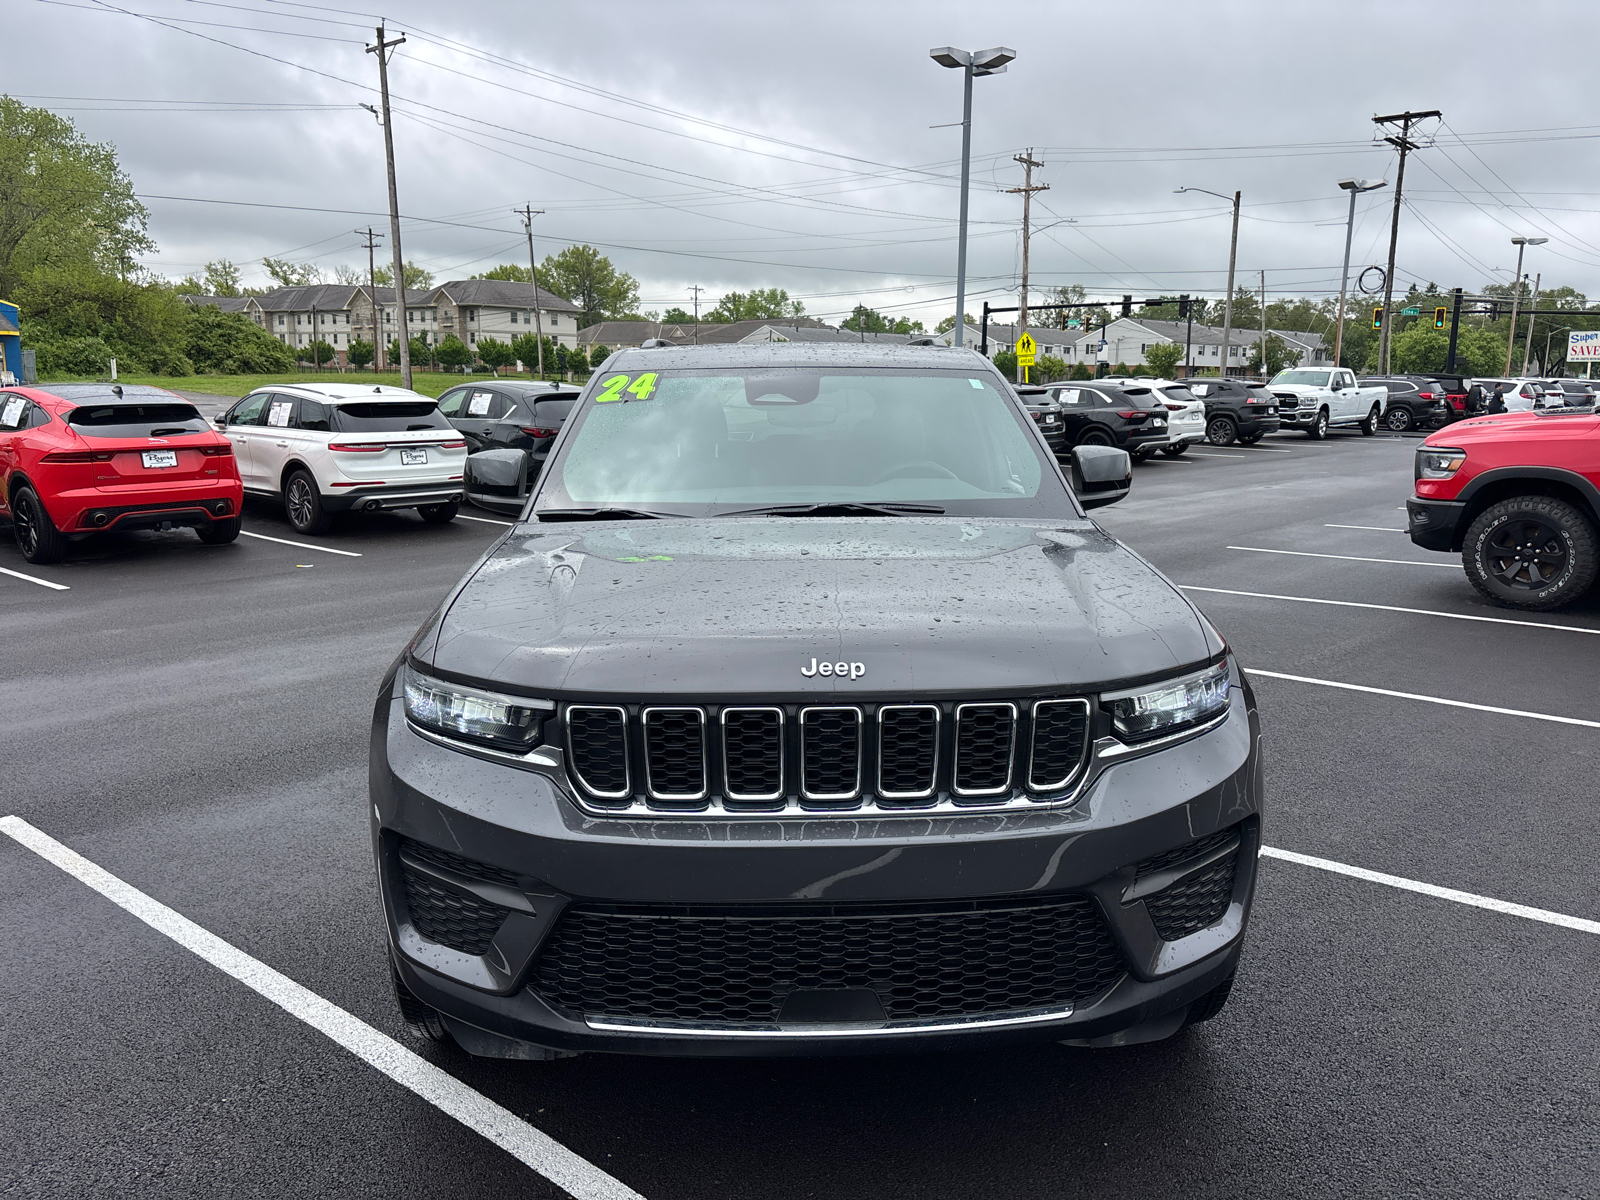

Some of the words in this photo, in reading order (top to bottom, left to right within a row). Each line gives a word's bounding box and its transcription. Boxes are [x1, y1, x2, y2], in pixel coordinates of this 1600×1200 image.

[1570, 333, 1599, 344] Super
[595, 372, 659, 403] 24
[1475, 515, 1508, 580] WRANGLER
[1538, 529, 1576, 598] GOODYEAR
[800, 657, 866, 681] Jeep
